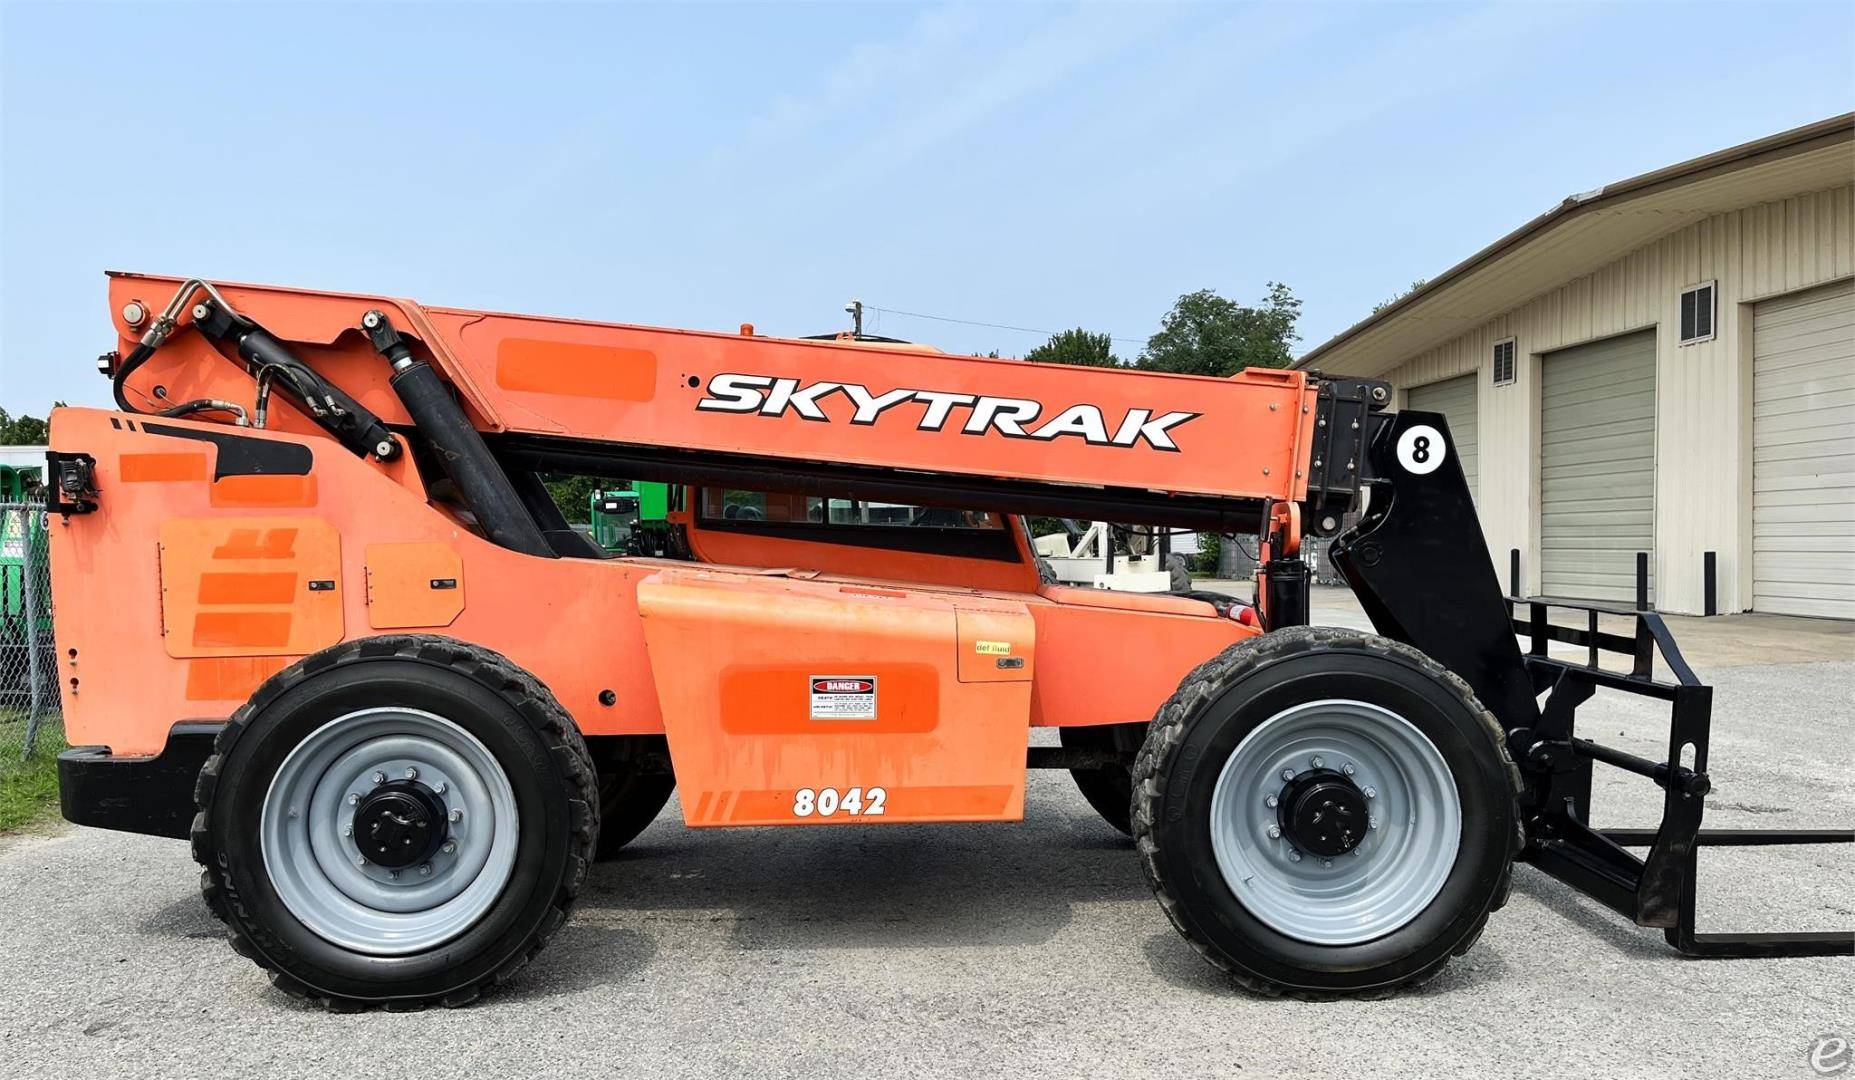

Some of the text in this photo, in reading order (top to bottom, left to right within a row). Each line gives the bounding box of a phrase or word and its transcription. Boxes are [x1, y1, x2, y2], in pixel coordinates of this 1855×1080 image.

[696, 373, 1203, 452] SKYTRAK
[1413, 436, 1429, 463] 8
[826, 682, 860, 690] DANGER
[793, 786, 887, 817] 8042
